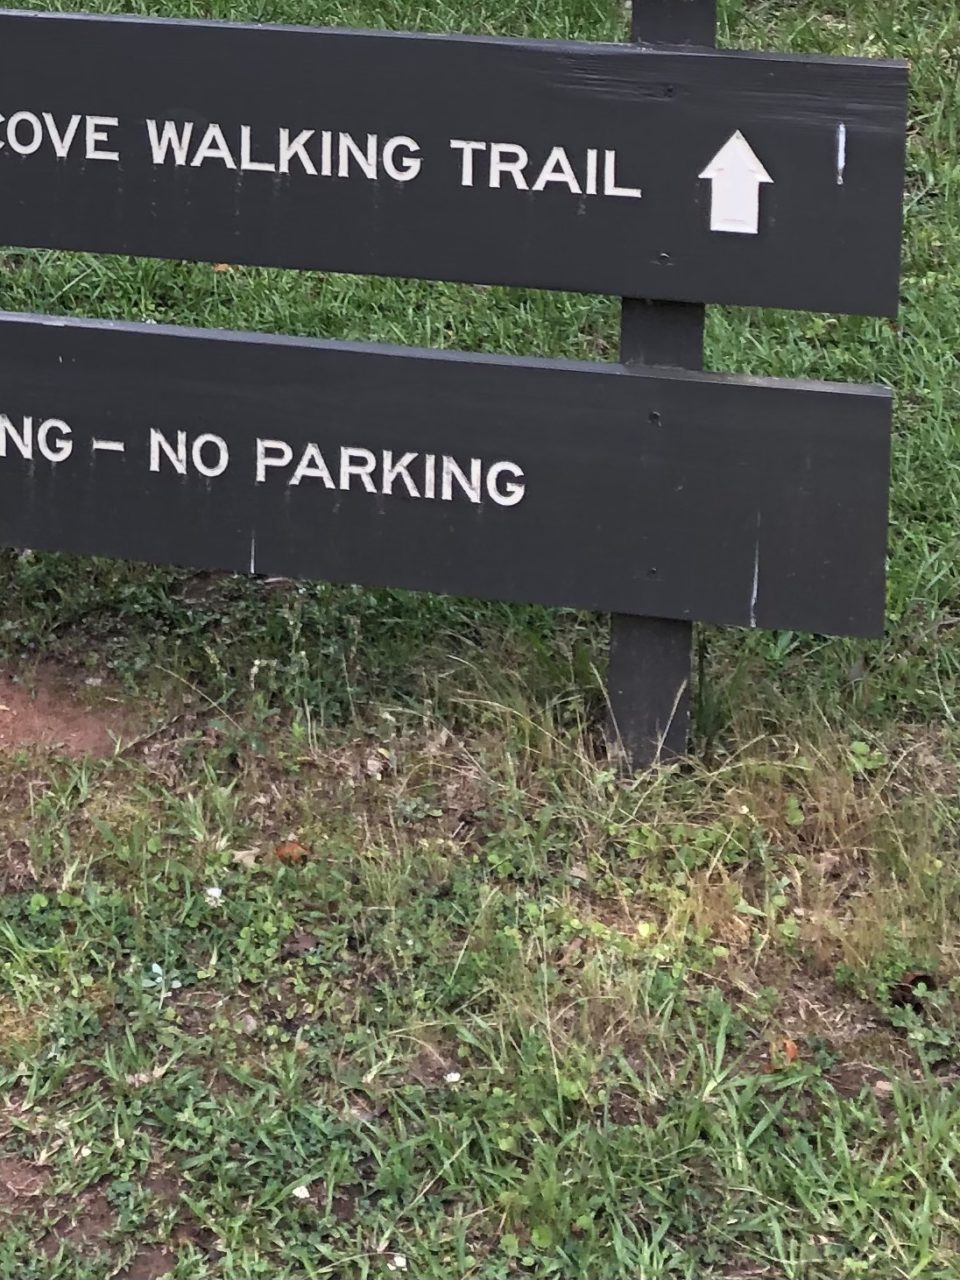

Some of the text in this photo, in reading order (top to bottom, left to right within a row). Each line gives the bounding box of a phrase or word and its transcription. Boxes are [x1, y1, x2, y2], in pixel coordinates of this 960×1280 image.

[144, 117, 422, 183] WALKING
[448, 138, 643, 199] TRAIL
[148, 426, 230, 478] NO
[254, 436, 526, 508] PARKING
